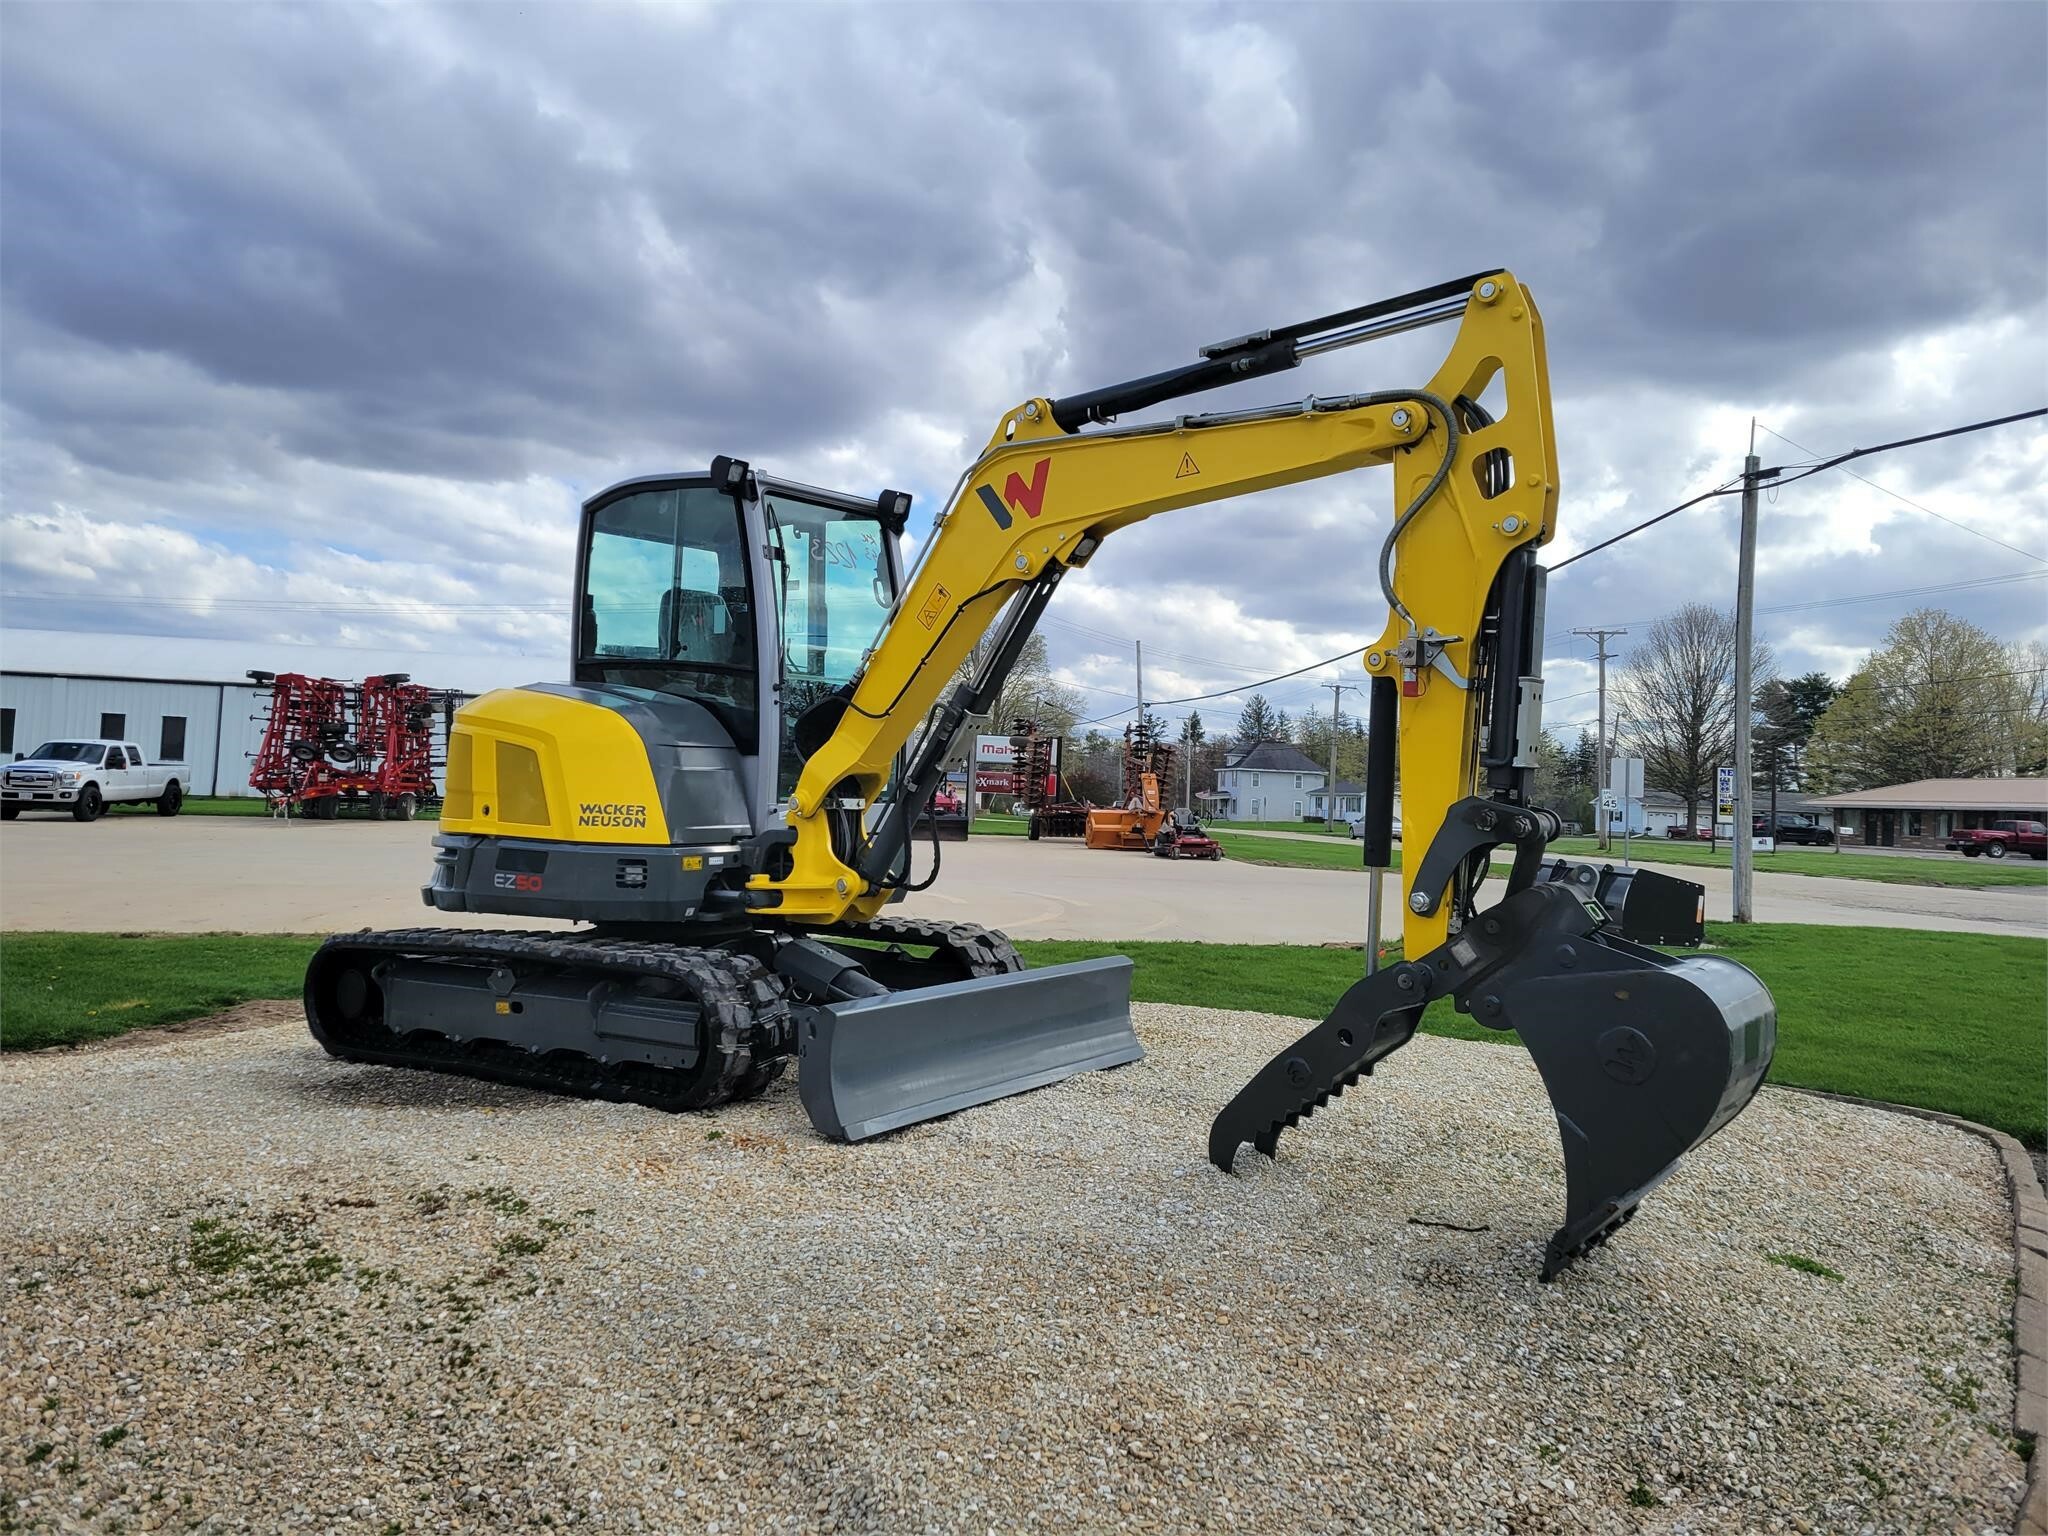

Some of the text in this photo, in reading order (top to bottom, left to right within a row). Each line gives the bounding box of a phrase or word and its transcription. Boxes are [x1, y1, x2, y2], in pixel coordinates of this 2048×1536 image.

[579, 803, 646, 816] WACKER
[1604, 800, 1617, 808] 45
[578, 815, 646, 828] NEUSON
[494, 873, 542, 892] EZ50
